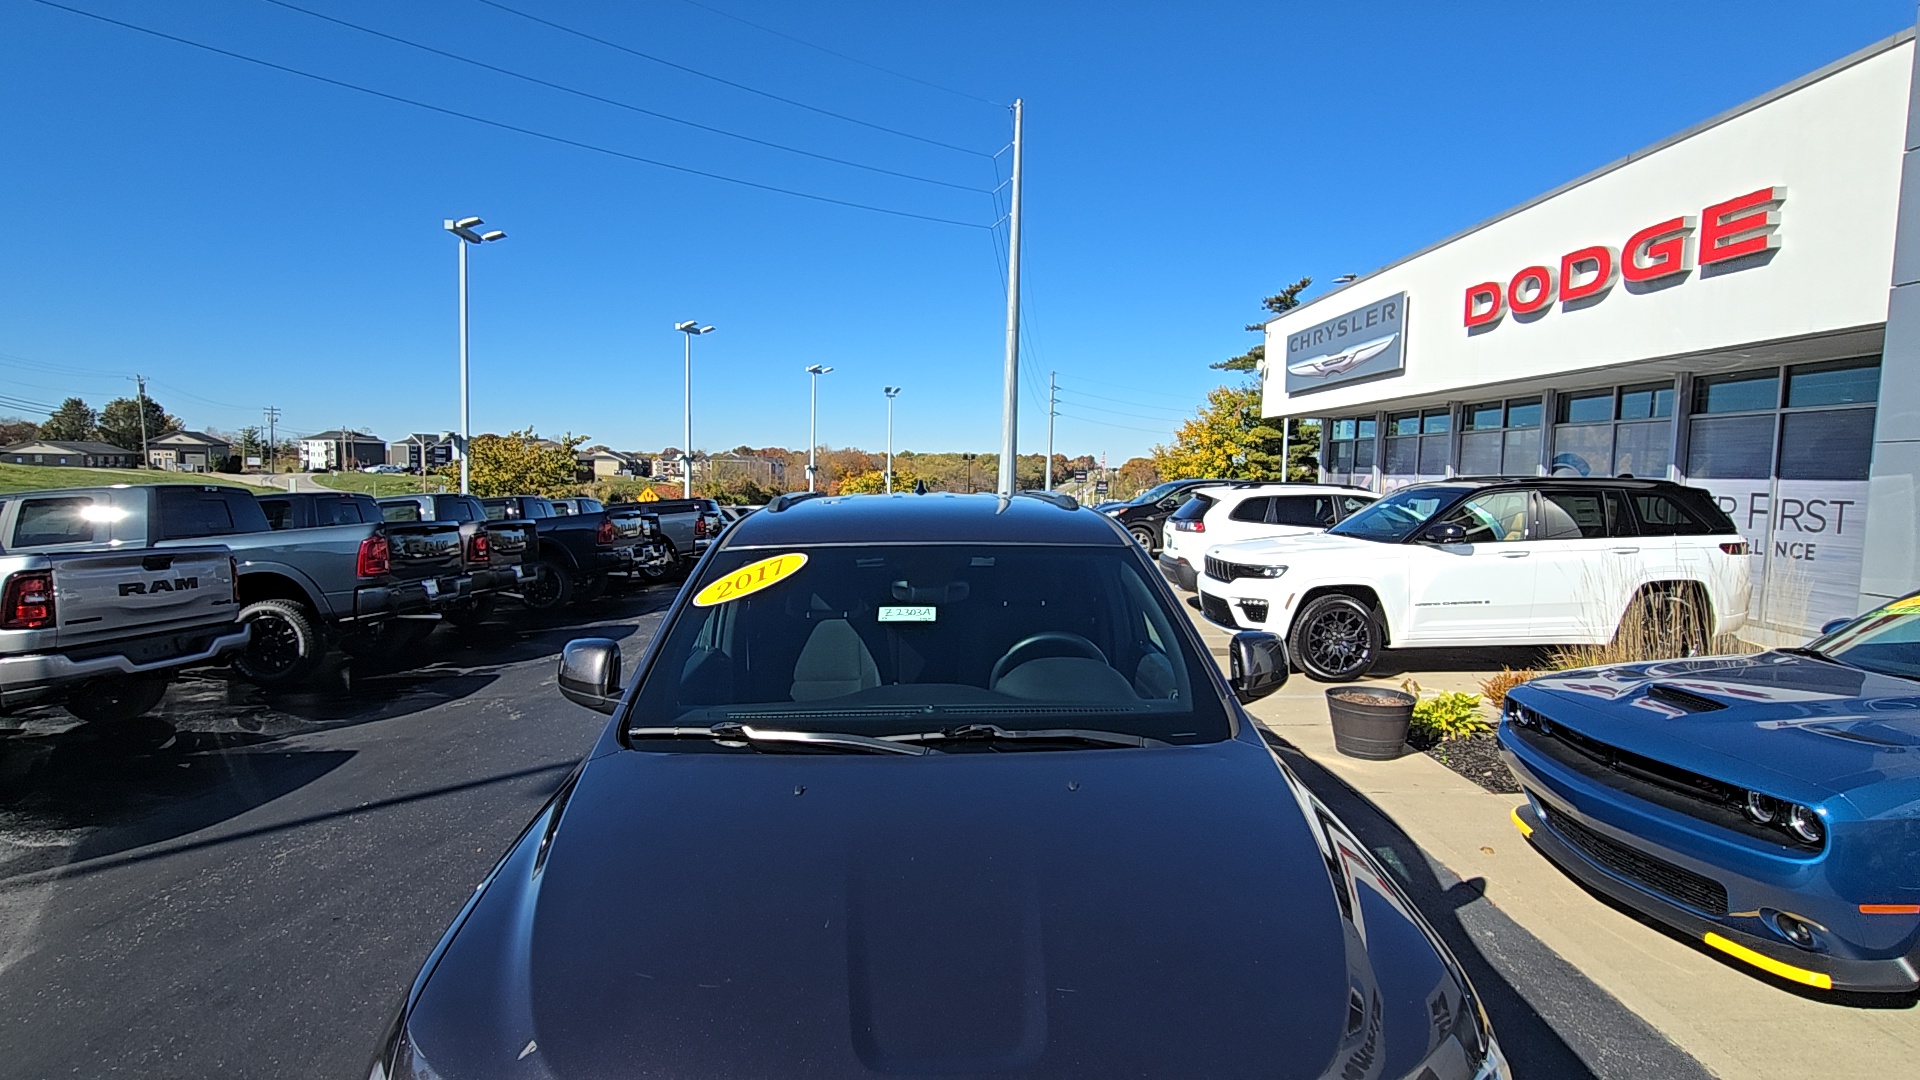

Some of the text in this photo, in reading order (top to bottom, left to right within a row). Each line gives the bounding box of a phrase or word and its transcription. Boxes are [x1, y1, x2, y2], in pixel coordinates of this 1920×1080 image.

[1464, 187, 1780, 327] DODGE
[1290, 302, 1396, 352] CHRYSLER
[118, 577, 198, 596] RAM
[716, 558, 784, 600] 2017
